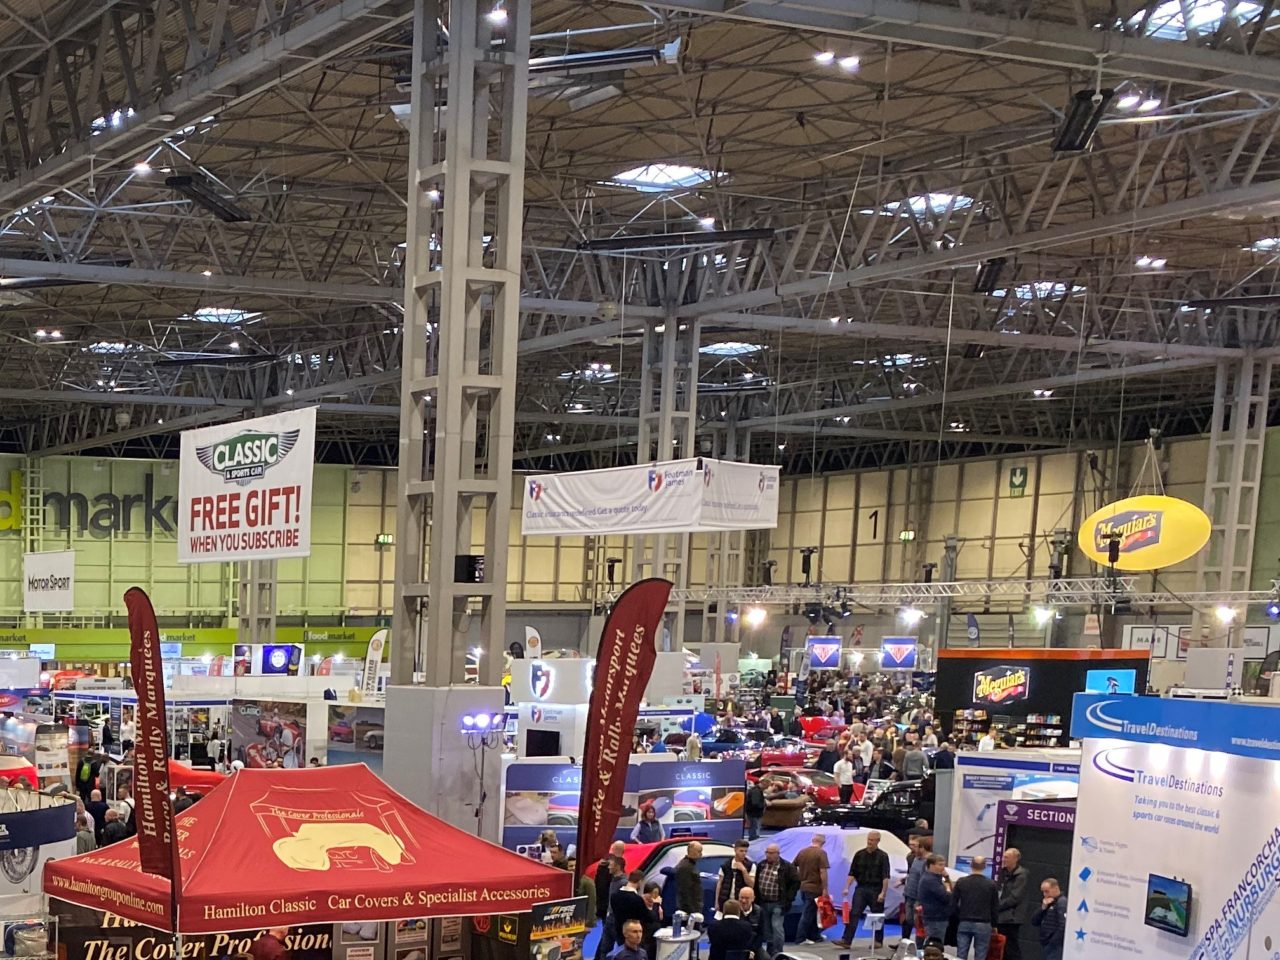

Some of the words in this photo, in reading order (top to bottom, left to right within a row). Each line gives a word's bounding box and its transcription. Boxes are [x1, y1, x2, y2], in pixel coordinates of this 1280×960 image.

[213, 436, 278, 470] CLASSIC
[231, 468, 250, 478] SPORTS
[251, 466, 263, 476] CAR
[664, 469, 693, 481] Footman
[665, 479, 685, 489] James
[44, 472, 178, 533] mark
[190, 492, 241, 532] FREE
[245, 485, 302, 528] GIFT!
[526, 510, 543, 519] Classic
[869, 509, 879, 540] 1
[190, 535, 217, 553] WHEN
[220, 533, 240, 551] YOU
[241, 528, 299, 550] SUBSCRIBE
[28, 576, 49, 593] MOTOR
[49, 574, 71, 592] SPORT
[142, 629, 160, 719] Marquees
[977, 669, 1025, 698] Meguiar's
[1123, 720, 1199, 741] TravelDestinations
[148, 725, 167, 772] Rally
[154, 779, 168, 792] &
[599, 768, 612, 786] &
[675, 772, 711, 780] CLASSIC
[1136, 770, 1224, 797] TravelDestinations
[134, 753, 157, 838] Hamilton
[1134, 795, 1157, 809] Taking
[1158, 799, 1169, 810] you
[1169, 799, 1175, 809] to
[1175, 801, 1184, 811] the
[1184, 802, 1196, 814] best
[1196, 805, 1215, 818] classic
[270, 807, 286, 816] The
[288, 811, 310, 819] Cover
[312, 808, 364, 820] Professionals
[1027, 808, 1075, 824] SECTION
[1132, 810, 1153, 822] sports
[1154, 814, 1163, 822] car
[1176, 816, 1194, 829] around
[1194, 818, 1203, 831] the
[1203, 822, 1220, 834] world
[52, 874, 164, 916] www.hamiltongrouponline.com
[204, 904, 266, 920] Hamilton
[269, 899, 317, 915] Classic
[327, 894, 351, 909] Car
[355, 892, 399, 908] Covers
[403, 892, 415, 906] &
[418, 887, 477, 906] Specialist
[480, 885, 550, 903] Accessories
[543, 913, 560, 921] SAFETY
[559, 904, 577, 915] FIRE
